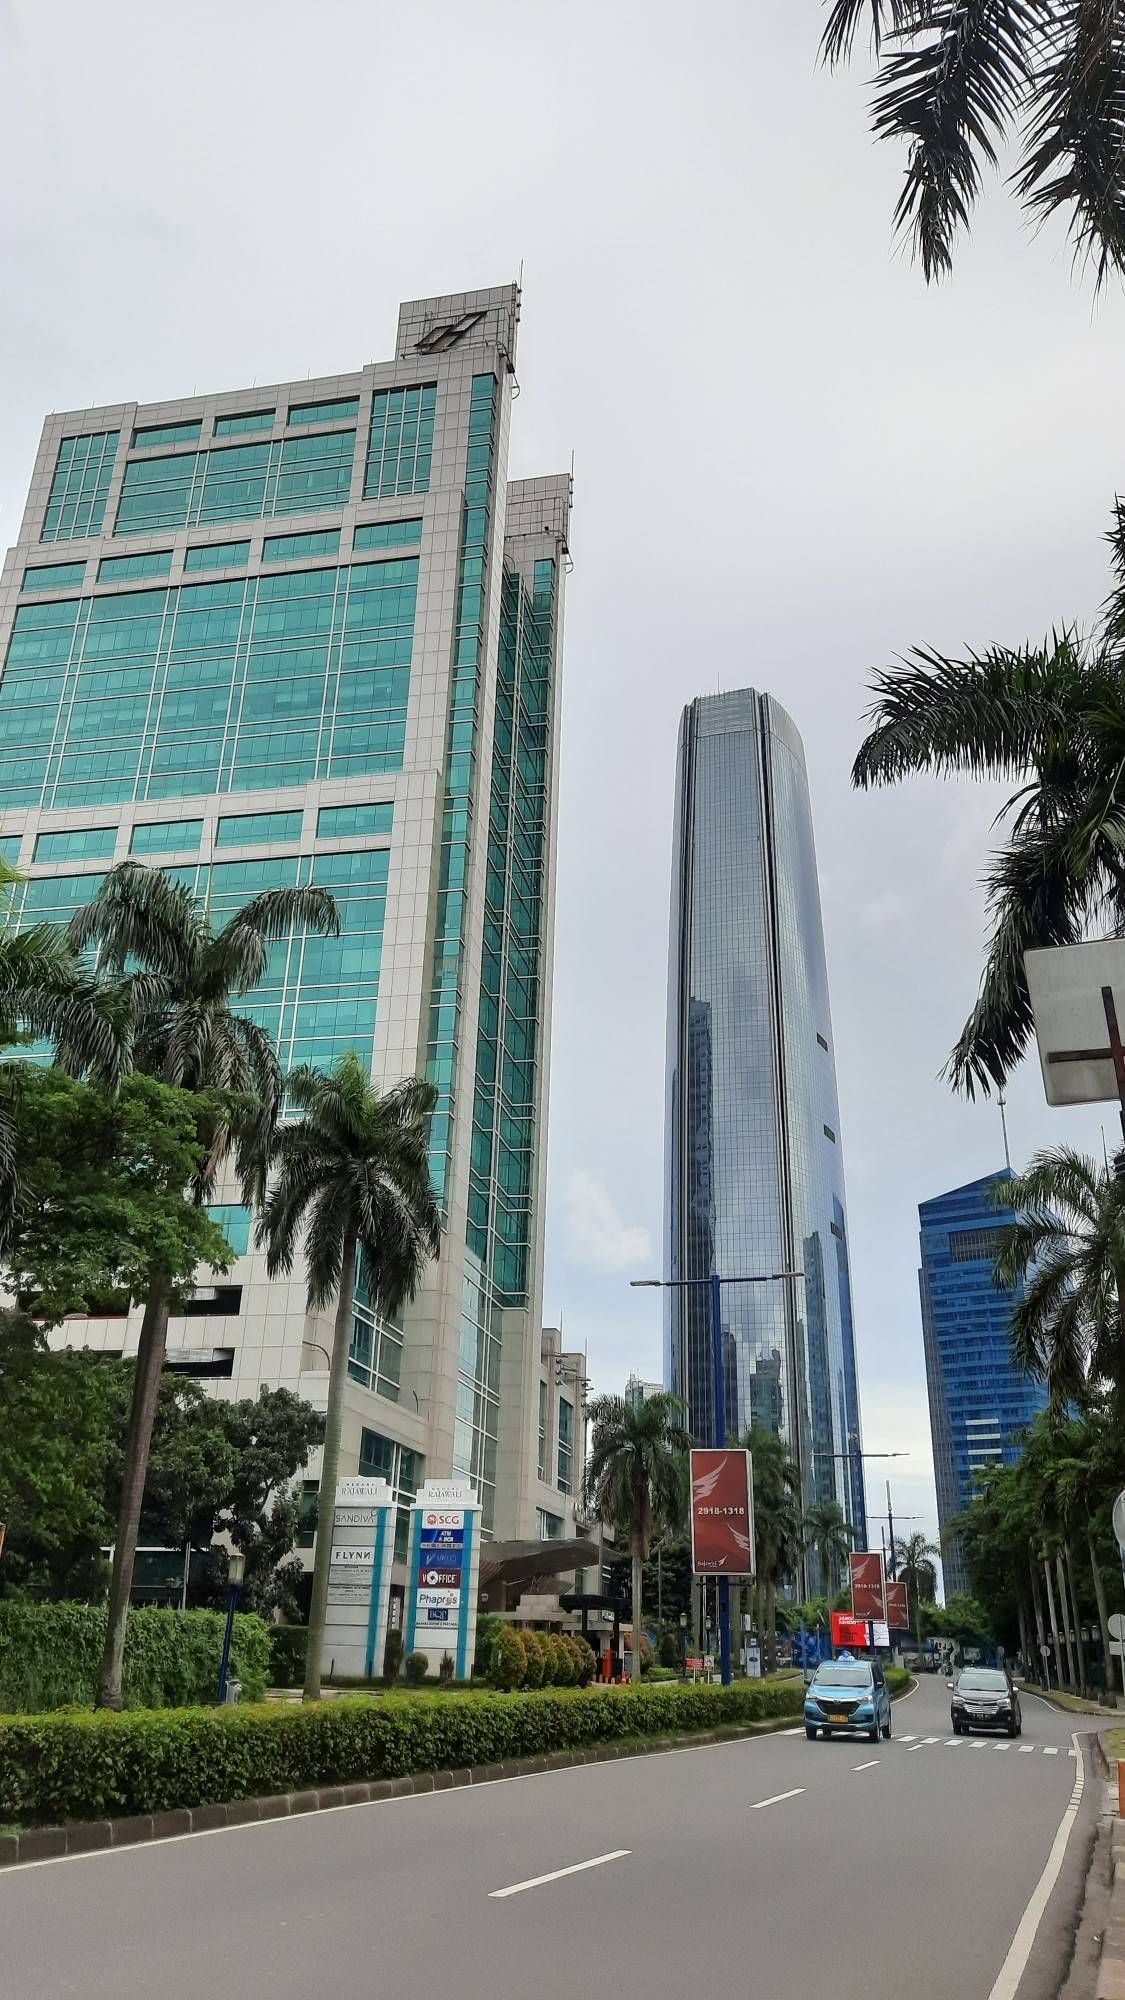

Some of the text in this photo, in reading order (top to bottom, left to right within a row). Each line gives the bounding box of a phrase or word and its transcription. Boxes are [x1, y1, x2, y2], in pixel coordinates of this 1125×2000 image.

[697, 1507, 745, 1515] 2918-1318
[438, 1515, 459, 1525] SCG
[335, 1551, 371, 1560] FLYNN
